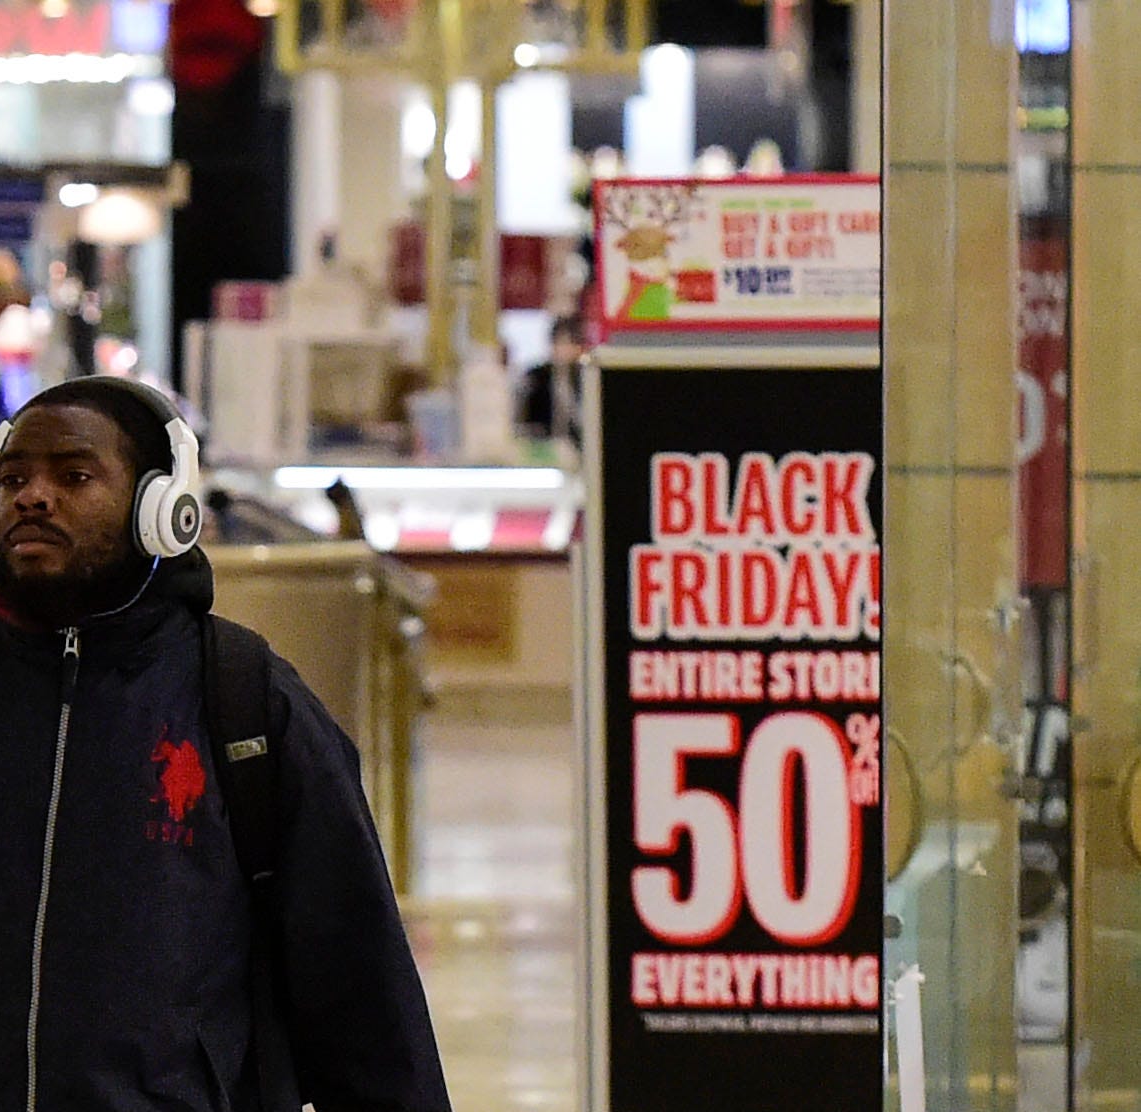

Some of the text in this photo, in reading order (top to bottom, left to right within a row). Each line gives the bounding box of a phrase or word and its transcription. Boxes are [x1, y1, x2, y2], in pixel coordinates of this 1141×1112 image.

[651, 452, 876, 541] BLACK
[629, 651, 764, 700] ENTIRE
[631, 953, 880, 1009] EVERYTHING
